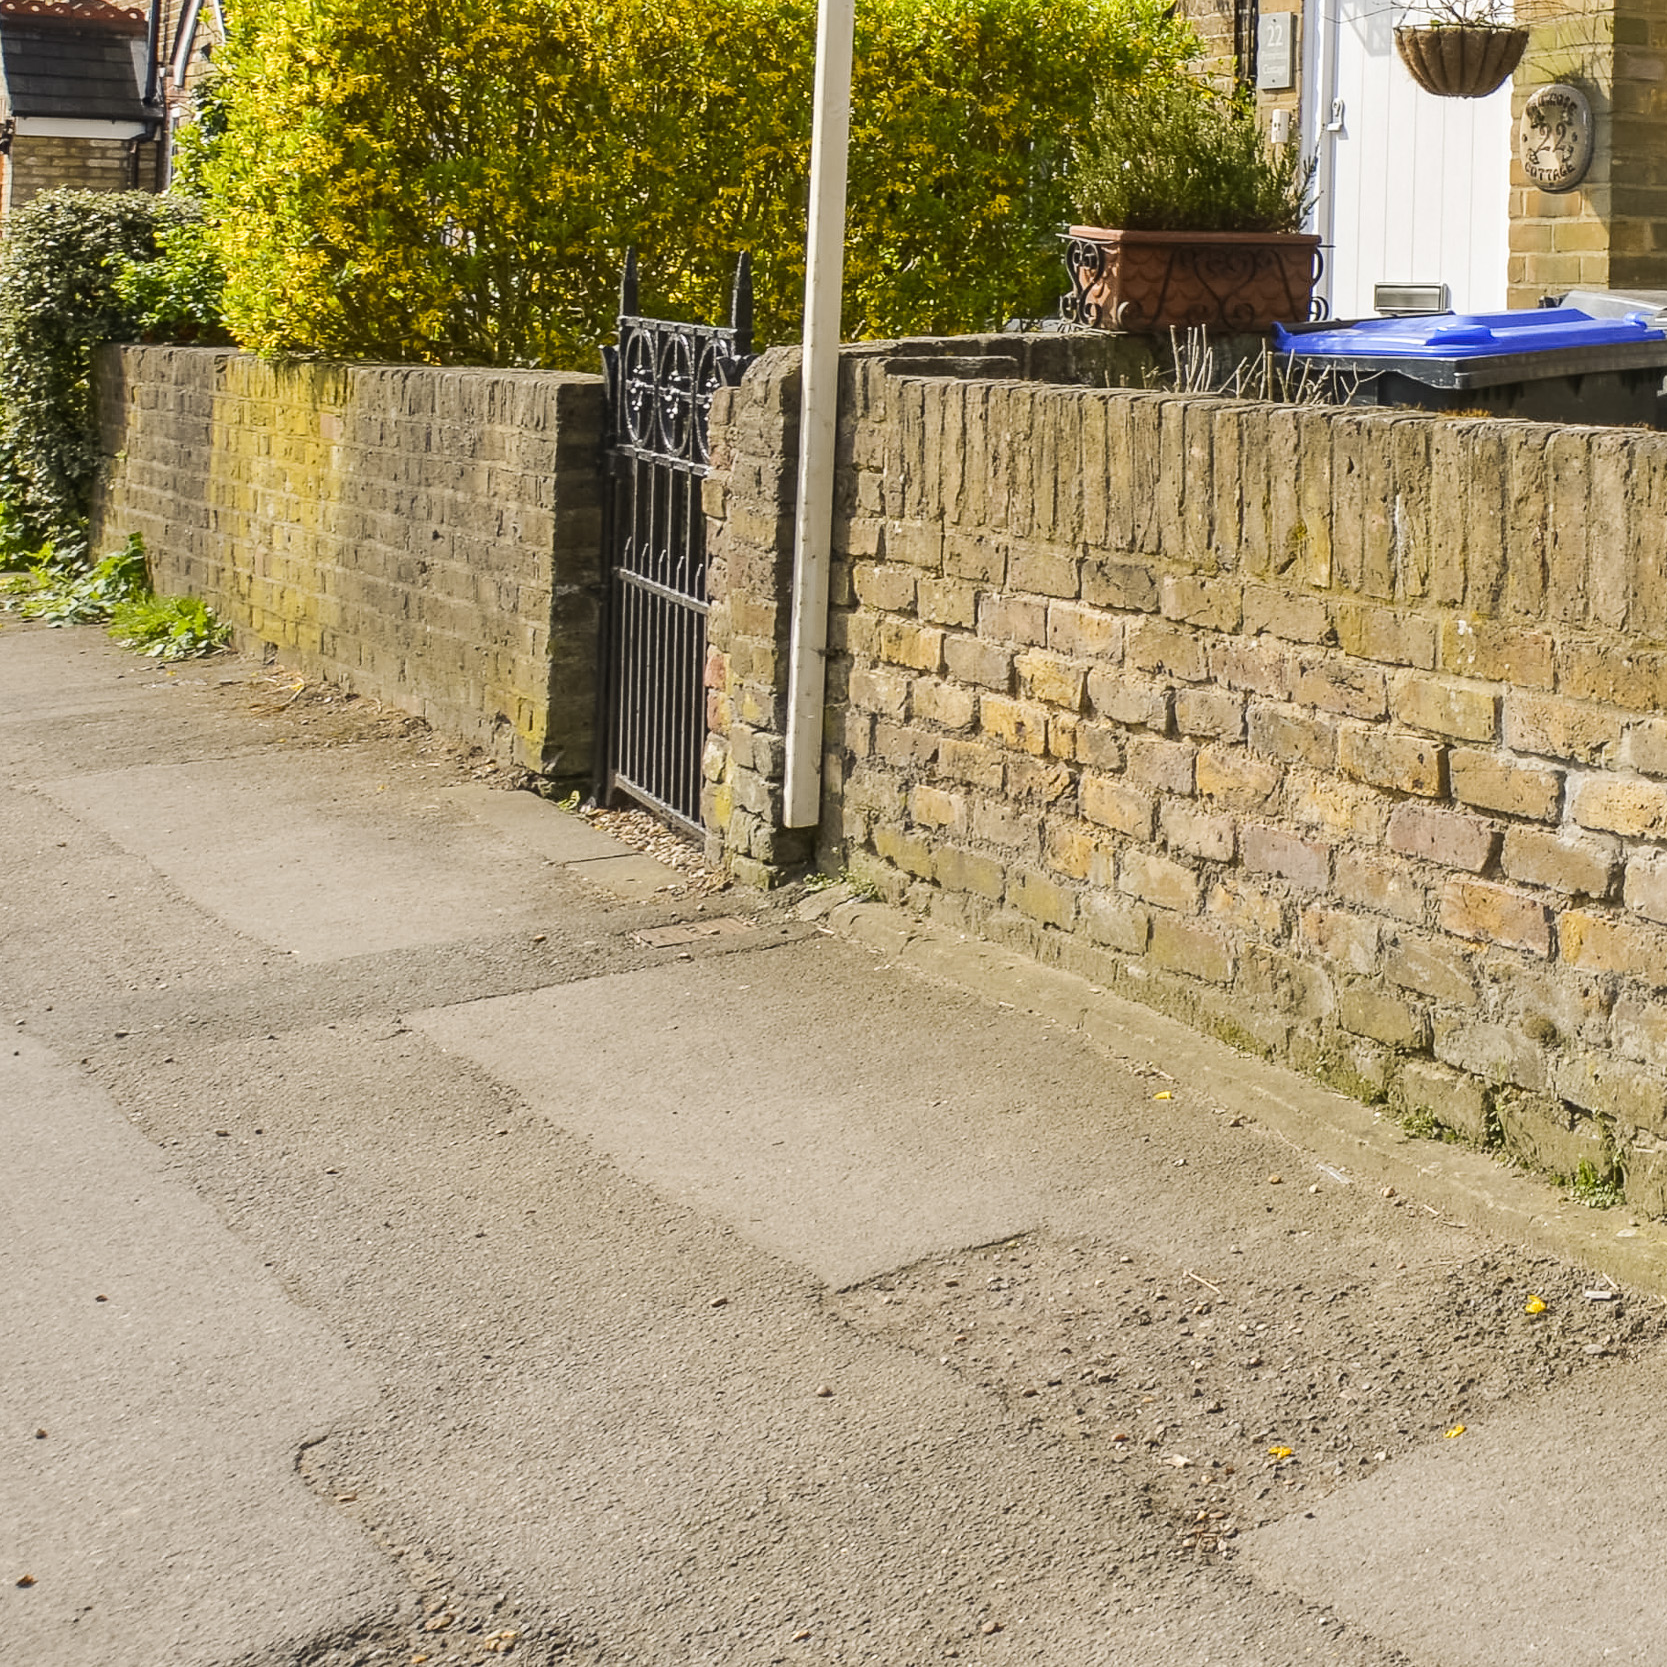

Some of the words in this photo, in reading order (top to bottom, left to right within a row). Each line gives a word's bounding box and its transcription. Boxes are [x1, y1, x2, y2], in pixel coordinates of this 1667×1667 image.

[1267, 24, 1283, 47] 22
[1535, 122, 1567, 154] 22
[1525, 161, 1576, 181] COTTAGE
